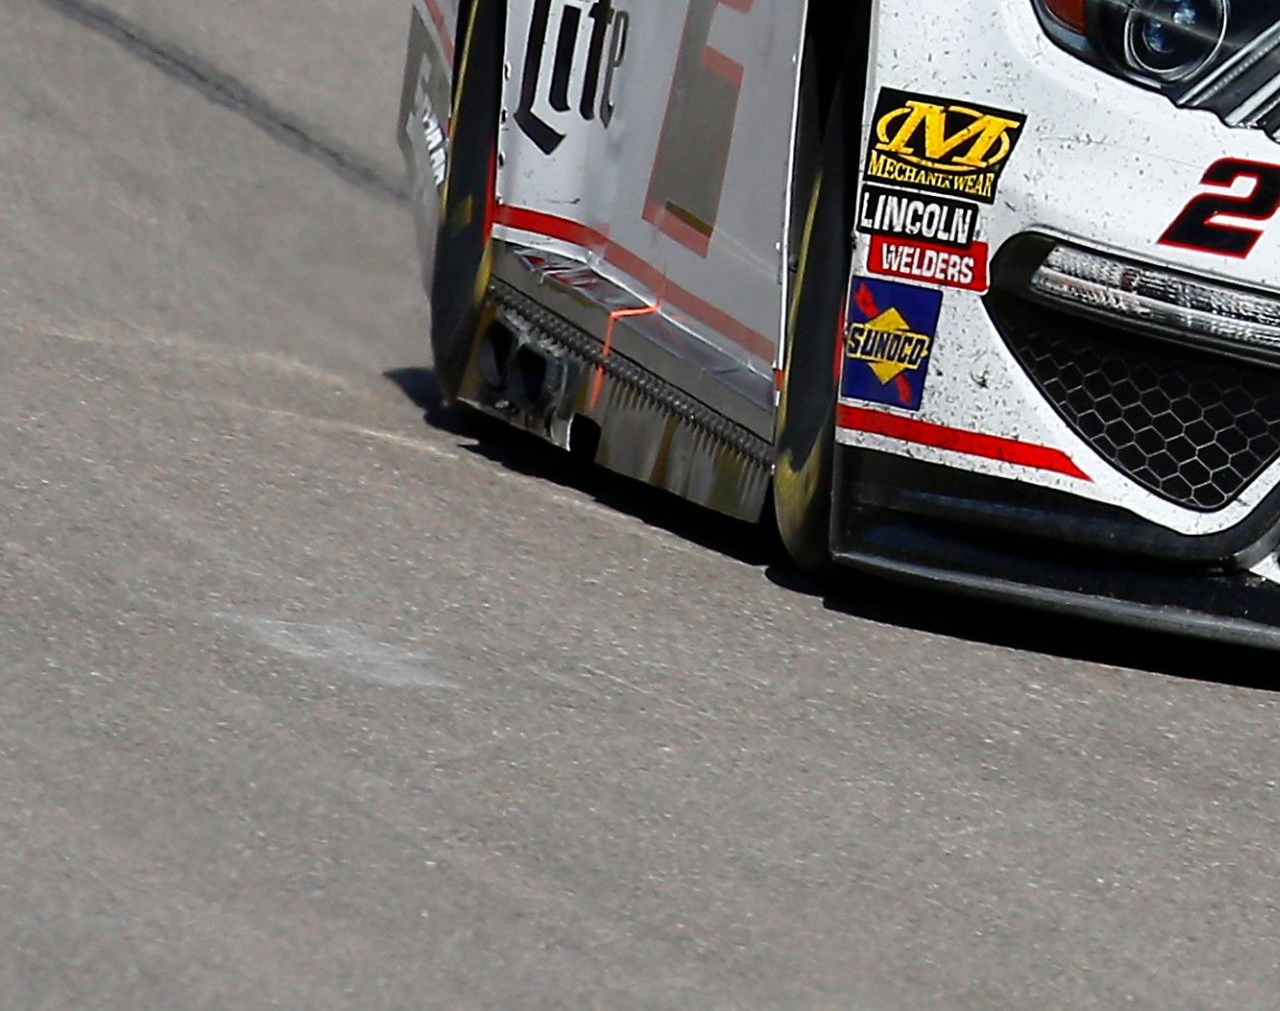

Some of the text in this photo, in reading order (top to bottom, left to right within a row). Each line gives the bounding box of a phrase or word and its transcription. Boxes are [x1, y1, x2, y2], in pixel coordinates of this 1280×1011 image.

[867, 150, 996, 198] MECHANIX WEAR
[860, 192, 973, 244] LINCOLN
[881, 242, 975, 284] WELDERS
[846, 322, 929, 369] SUNOCO
